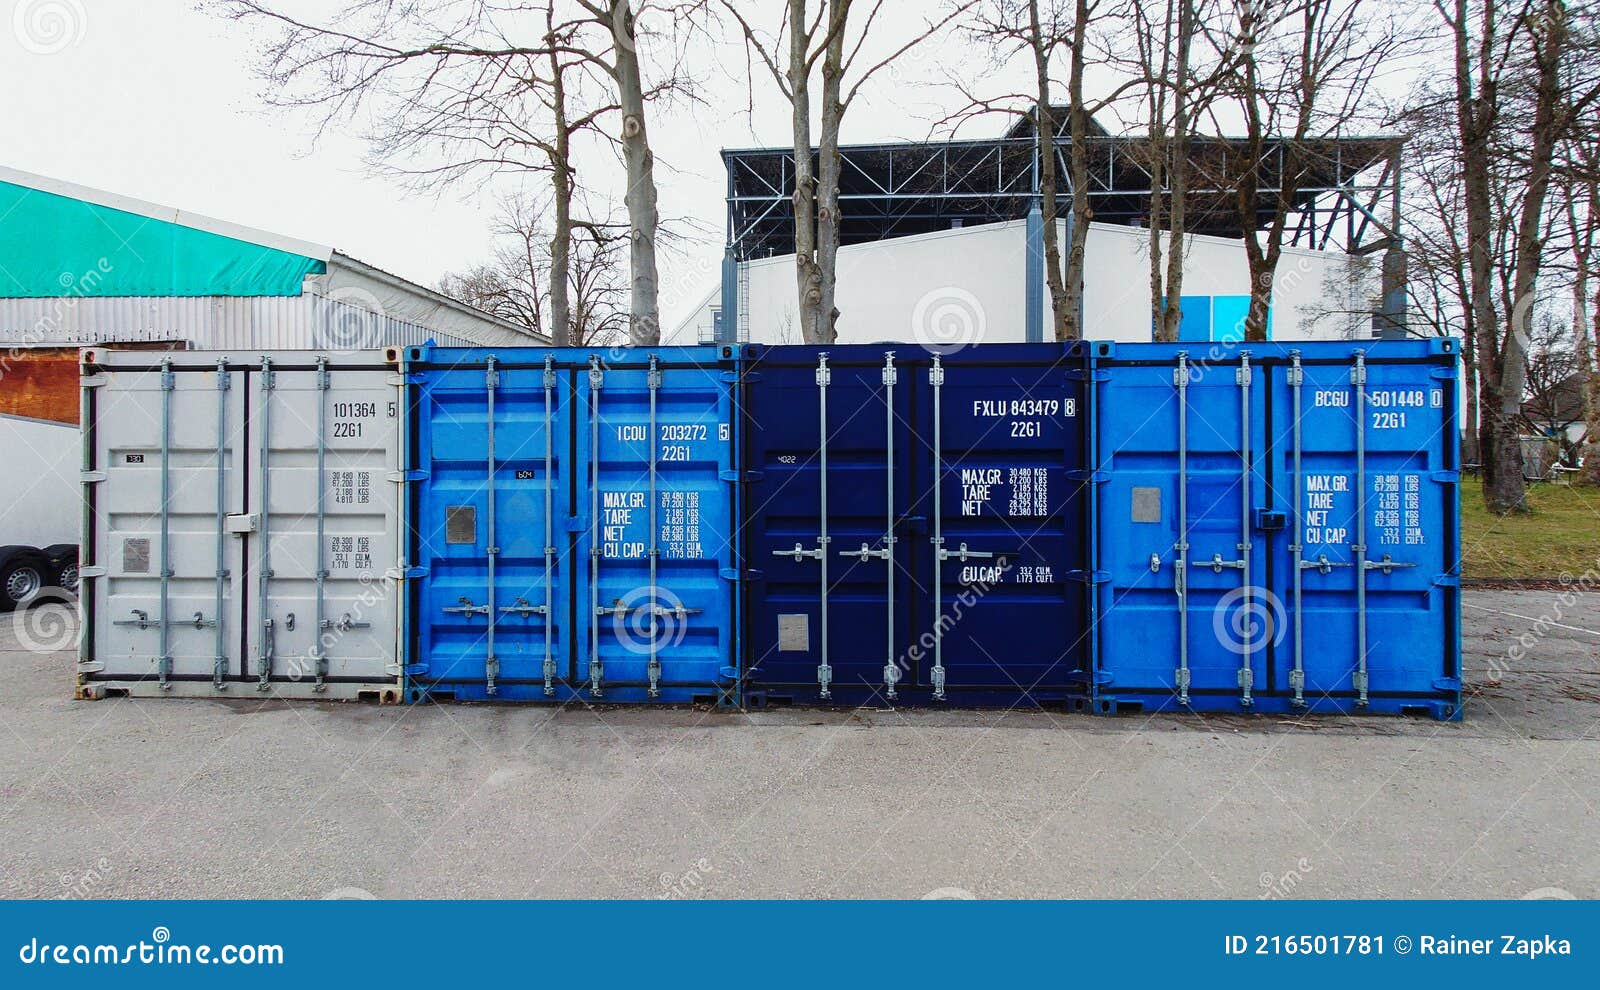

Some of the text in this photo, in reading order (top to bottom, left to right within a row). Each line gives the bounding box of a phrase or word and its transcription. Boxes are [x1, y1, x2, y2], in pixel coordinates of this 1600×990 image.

[1315, 391, 1349, 407] BCGU
[1372, 391, 1424, 407] 501448
[334, 402, 396, 418] 101364 5
[974, 399, 1075, 416] FXLU 843479 8
[1373, 412, 1406, 428] 22G1
[334, 423, 362, 437] 22G1
[618, 424, 730, 440] ICOU 203272 5
[1011, 422, 1040, 437] 22G1
[662, 446, 690, 461] 22G1
[962, 469, 1004, 484] MAX.GR.
[1034, 468, 1047, 476] KGS
[1034, 476, 1047, 484] LBS
[1307, 475, 1350, 491] MAX.GR.
[604, 492, 646, 508] MAX.GR.
[687, 492, 699, 500] KGS
[962, 485, 991, 500] TARE
[1034, 492, 1047, 500] LBS
[687, 500, 699, 508] LBS
[1307, 493, 1334, 508] TARE
[962, 501, 982, 516] NET
[1034, 507, 1047, 515] LBS
[604, 509, 632, 524] TARE
[1307, 510, 1328, 526] NET
[604, 526, 625, 541] NET
[1307, 528, 1350, 543] CU. CAP.
[604, 543, 647, 558] CU. CAP.
